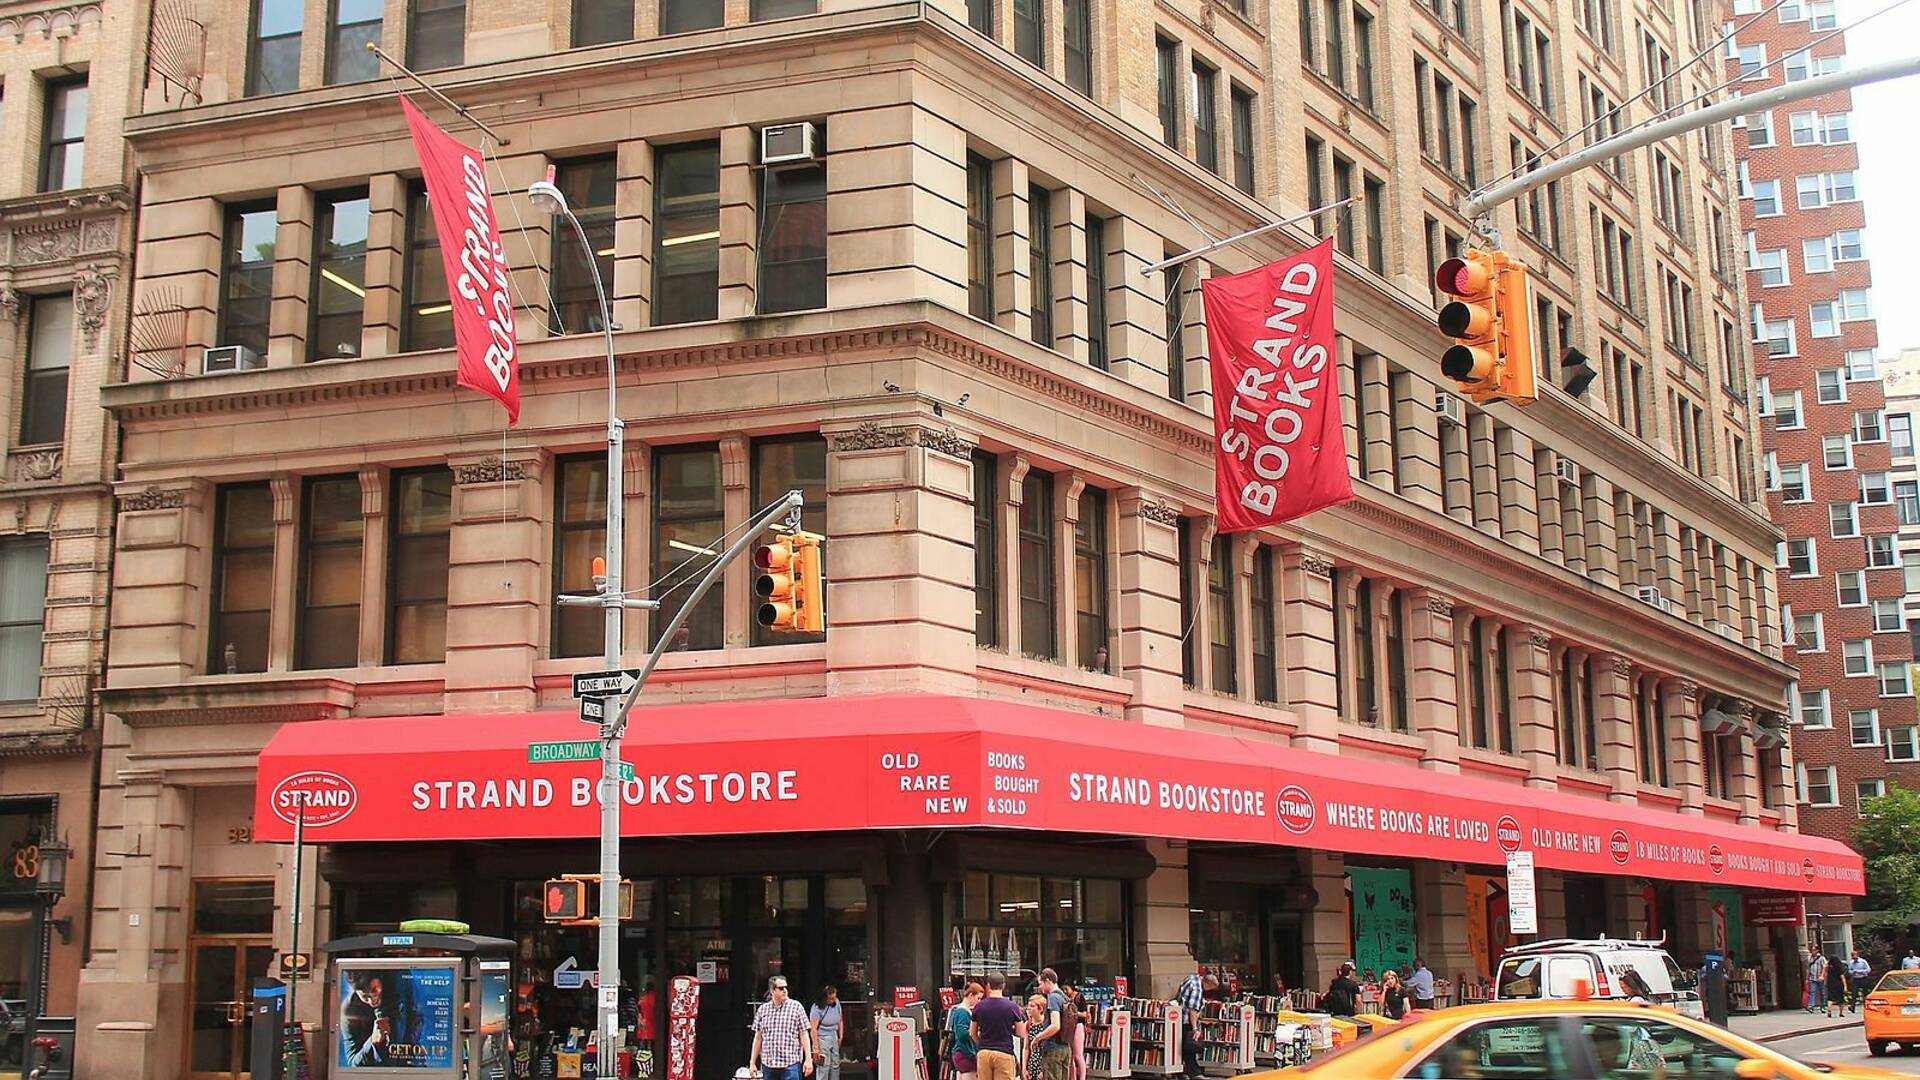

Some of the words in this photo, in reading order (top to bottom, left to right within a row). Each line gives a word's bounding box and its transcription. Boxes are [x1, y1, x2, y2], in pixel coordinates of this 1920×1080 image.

[457, 155, 490, 316] STRAND
[1221, 262, 1319, 461] STRAND
[1240, 342, 1328, 517] BOOKS
[580, 680, 598, 690] ONE
[604, 678, 622, 688] WAY
[533, 743, 596, 760] BROADWAY
[881, 753, 919, 769] OLD
[988, 752, 1025, 770] BOOKS
[412, 779, 553, 810] STRAND
[571, 770, 798, 806] BOKSTORE
[900, 775, 950, 791] RARE
[995, 775, 1039, 793] BOUGHT
[279, 790, 350, 807] STRAND
[1069, 772, 1151, 806] STRAND
[1159, 781, 1265, 816] BOOKSTORE
[926, 797, 968, 813] NEW
[987, 798, 996, 813] &
[997, 799, 1026, 815] SOLD
[1280, 800, 1312, 818] STRAND
[1325, 802, 1375, 830] WHERE
[1380, 808, 1423, 834] BOOKS
[1427, 815, 1450, 838] ARE
[1454, 818, 1489, 842] LOVED
[1498, 828, 1519, 842] STRAND
[1532, 827, 1552, 848] OLD
[1555, 831, 1579, 851] RARE
[1582, 834, 1601, 853] NEW
[14, 845, 38, 878] 83
[1636, 841, 1645, 858] 18
[1647, 843, 1669, 862] MILES
[1671, 846, 1680, 862] OF
[1682, 848, 1706, 865] BOOKS
[387, 937, 410, 945] TITAN
[707, 940, 726, 950] ATM
[389, 1043, 411, 1055] GET
[413, 1044, 428, 1056] ON
[583, 1063, 597, 1072] REA
